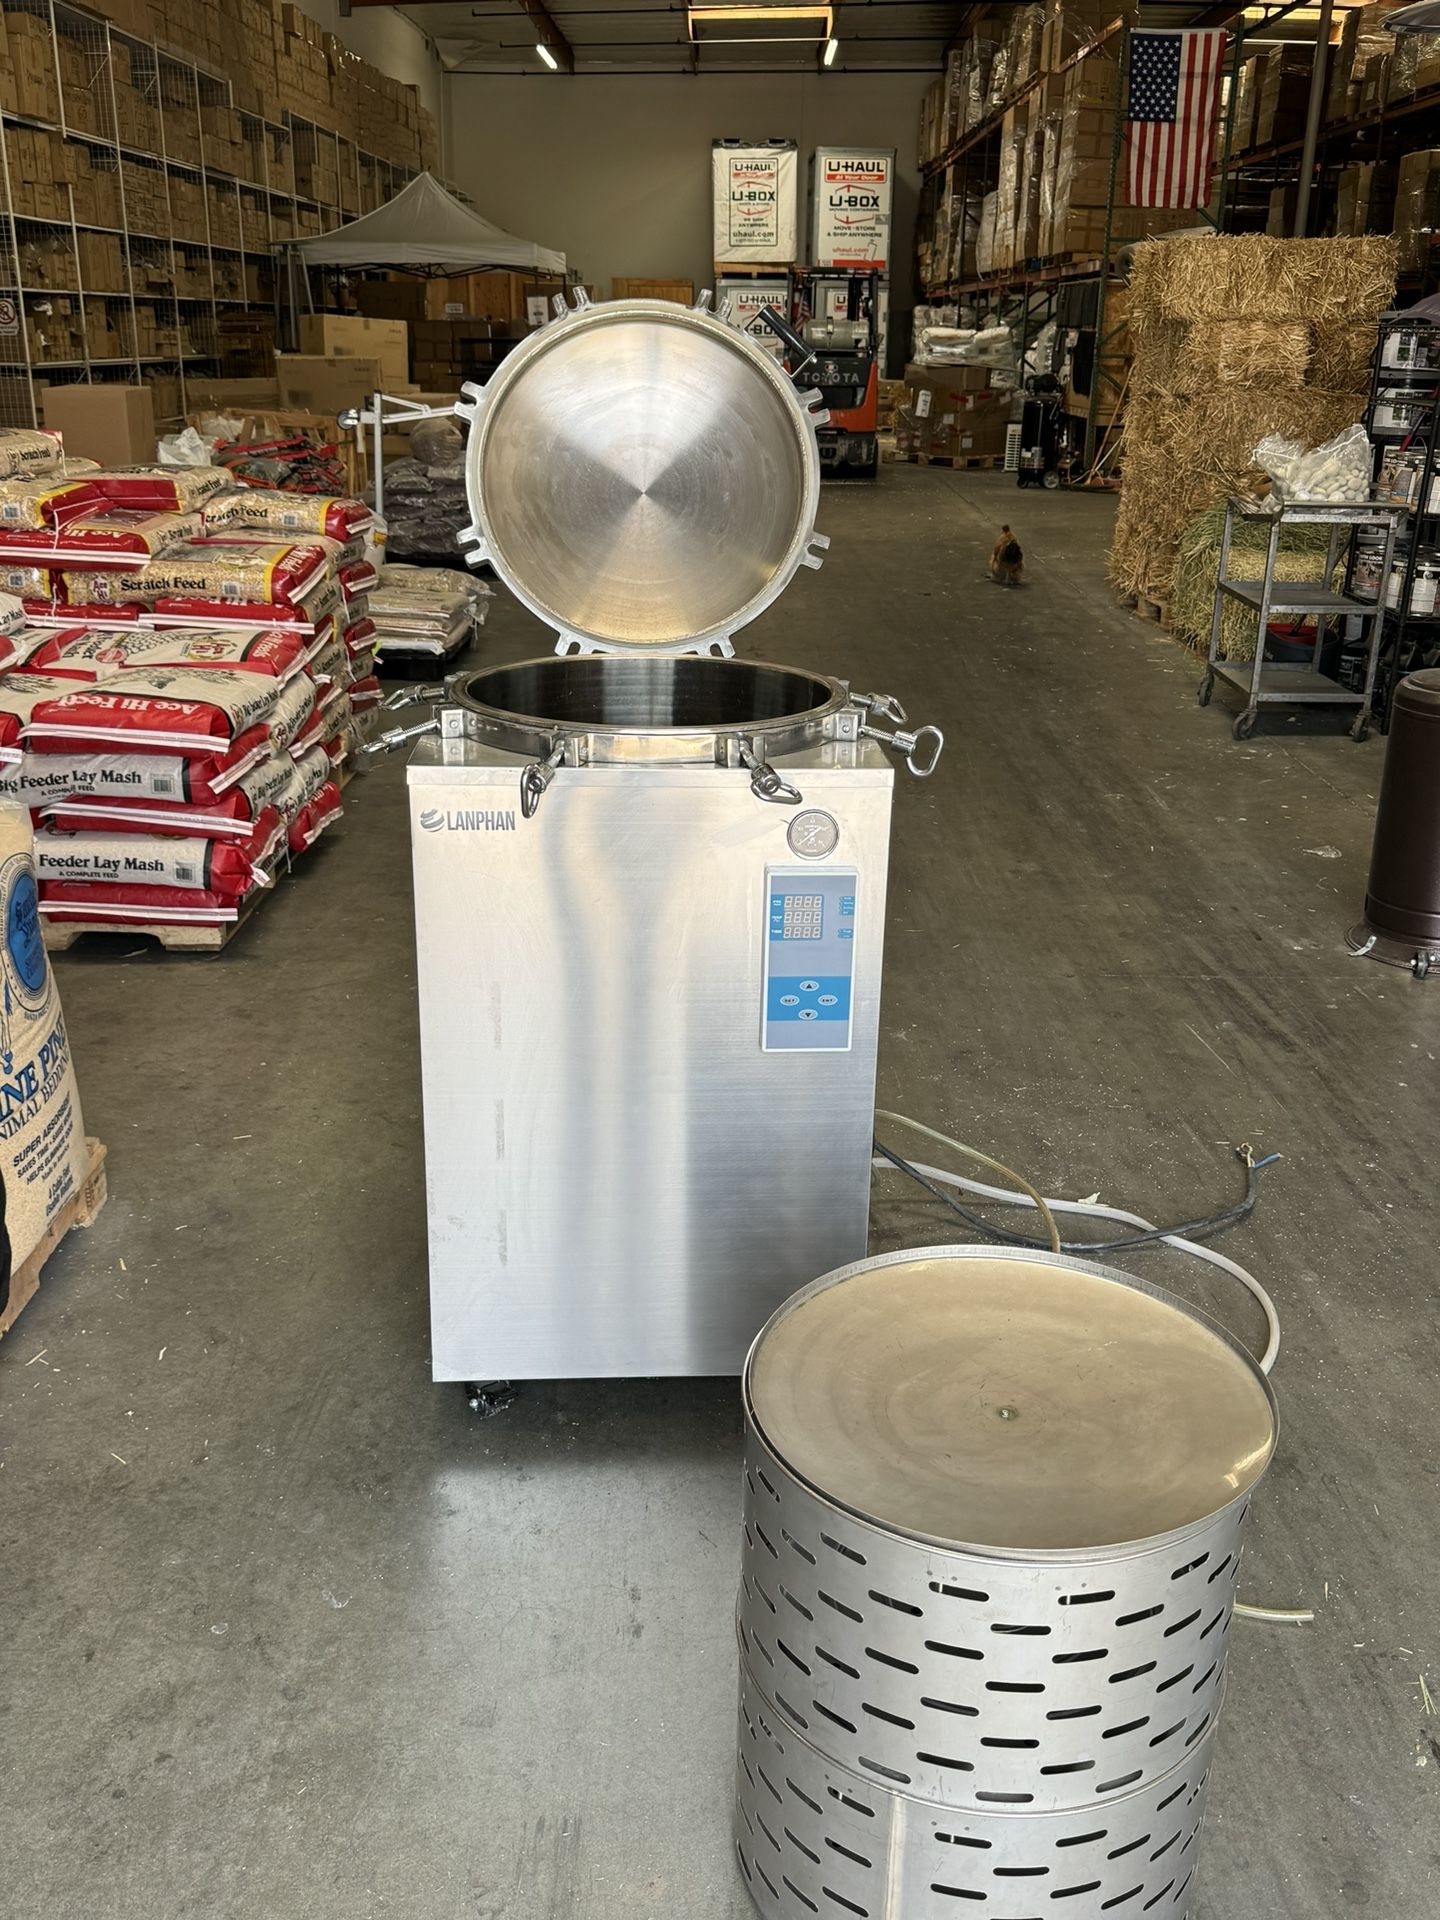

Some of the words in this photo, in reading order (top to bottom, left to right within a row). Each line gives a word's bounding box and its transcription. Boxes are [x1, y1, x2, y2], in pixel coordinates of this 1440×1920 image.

[734, 163, 772, 172] U-HAUL
[828, 161, 885, 173] U-HAUL
[732, 191, 776, 201] U-BOX
[829, 195, 880, 207] U-BOX
[733, 230, 775, 238] uhaul.com
[739, 295, 781, 305] U-HAUL
[802, 372, 860, 383] TOYOTA
[120, 578, 170, 592] Scratch
[173, 577, 206, 590] Feed
[120, 699, 152, 711] Hi
[154, 701, 201, 715] Ace
[20, 773, 70, 790] Feeder
[72, 769, 97, 785] Lay
[100, 769, 142, 785] Mash
[77, 784, 95, 792] FEED
[446, 810, 516, 831] LANPHAN
[39, 853, 90, 869] Feeder
[93, 855, 122, 872] Lay
[124, 857, 164, 872] Mash
[65, 870, 101, 878] COMPLETE
[102, 871, 119, 879] FEED
[13, 1135, 42, 1167] SUPER
[17, 1156, 36, 1178] SAVES
[27, 1163, 45, 1185] HELPS
